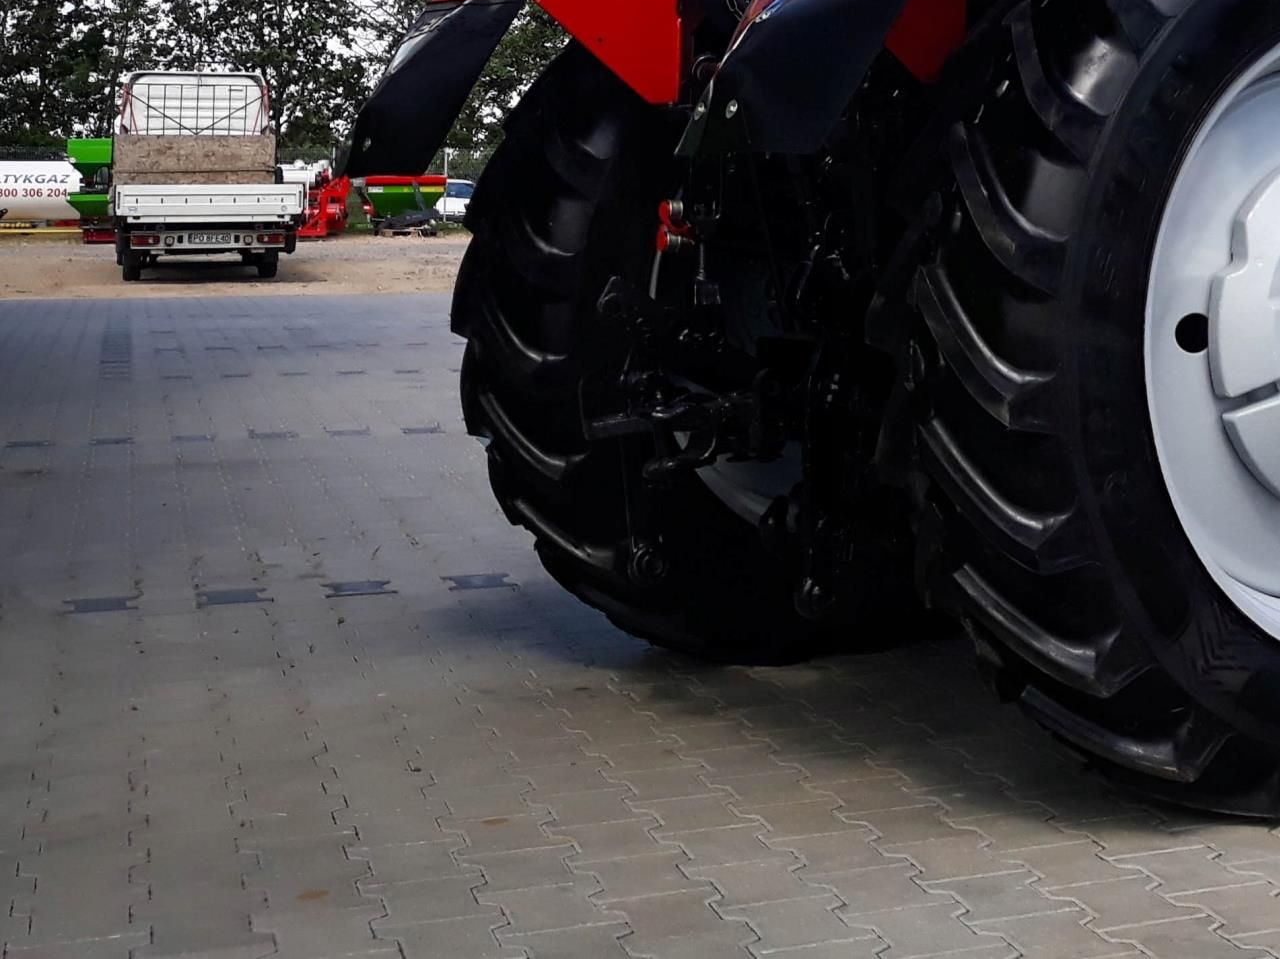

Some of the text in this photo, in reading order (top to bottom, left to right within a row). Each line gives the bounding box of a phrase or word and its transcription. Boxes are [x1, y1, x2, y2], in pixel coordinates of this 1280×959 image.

[0, 174, 71, 184] TYKGAZ
[22, 188, 43, 197] 306
[47, 188, 67, 197] 204
